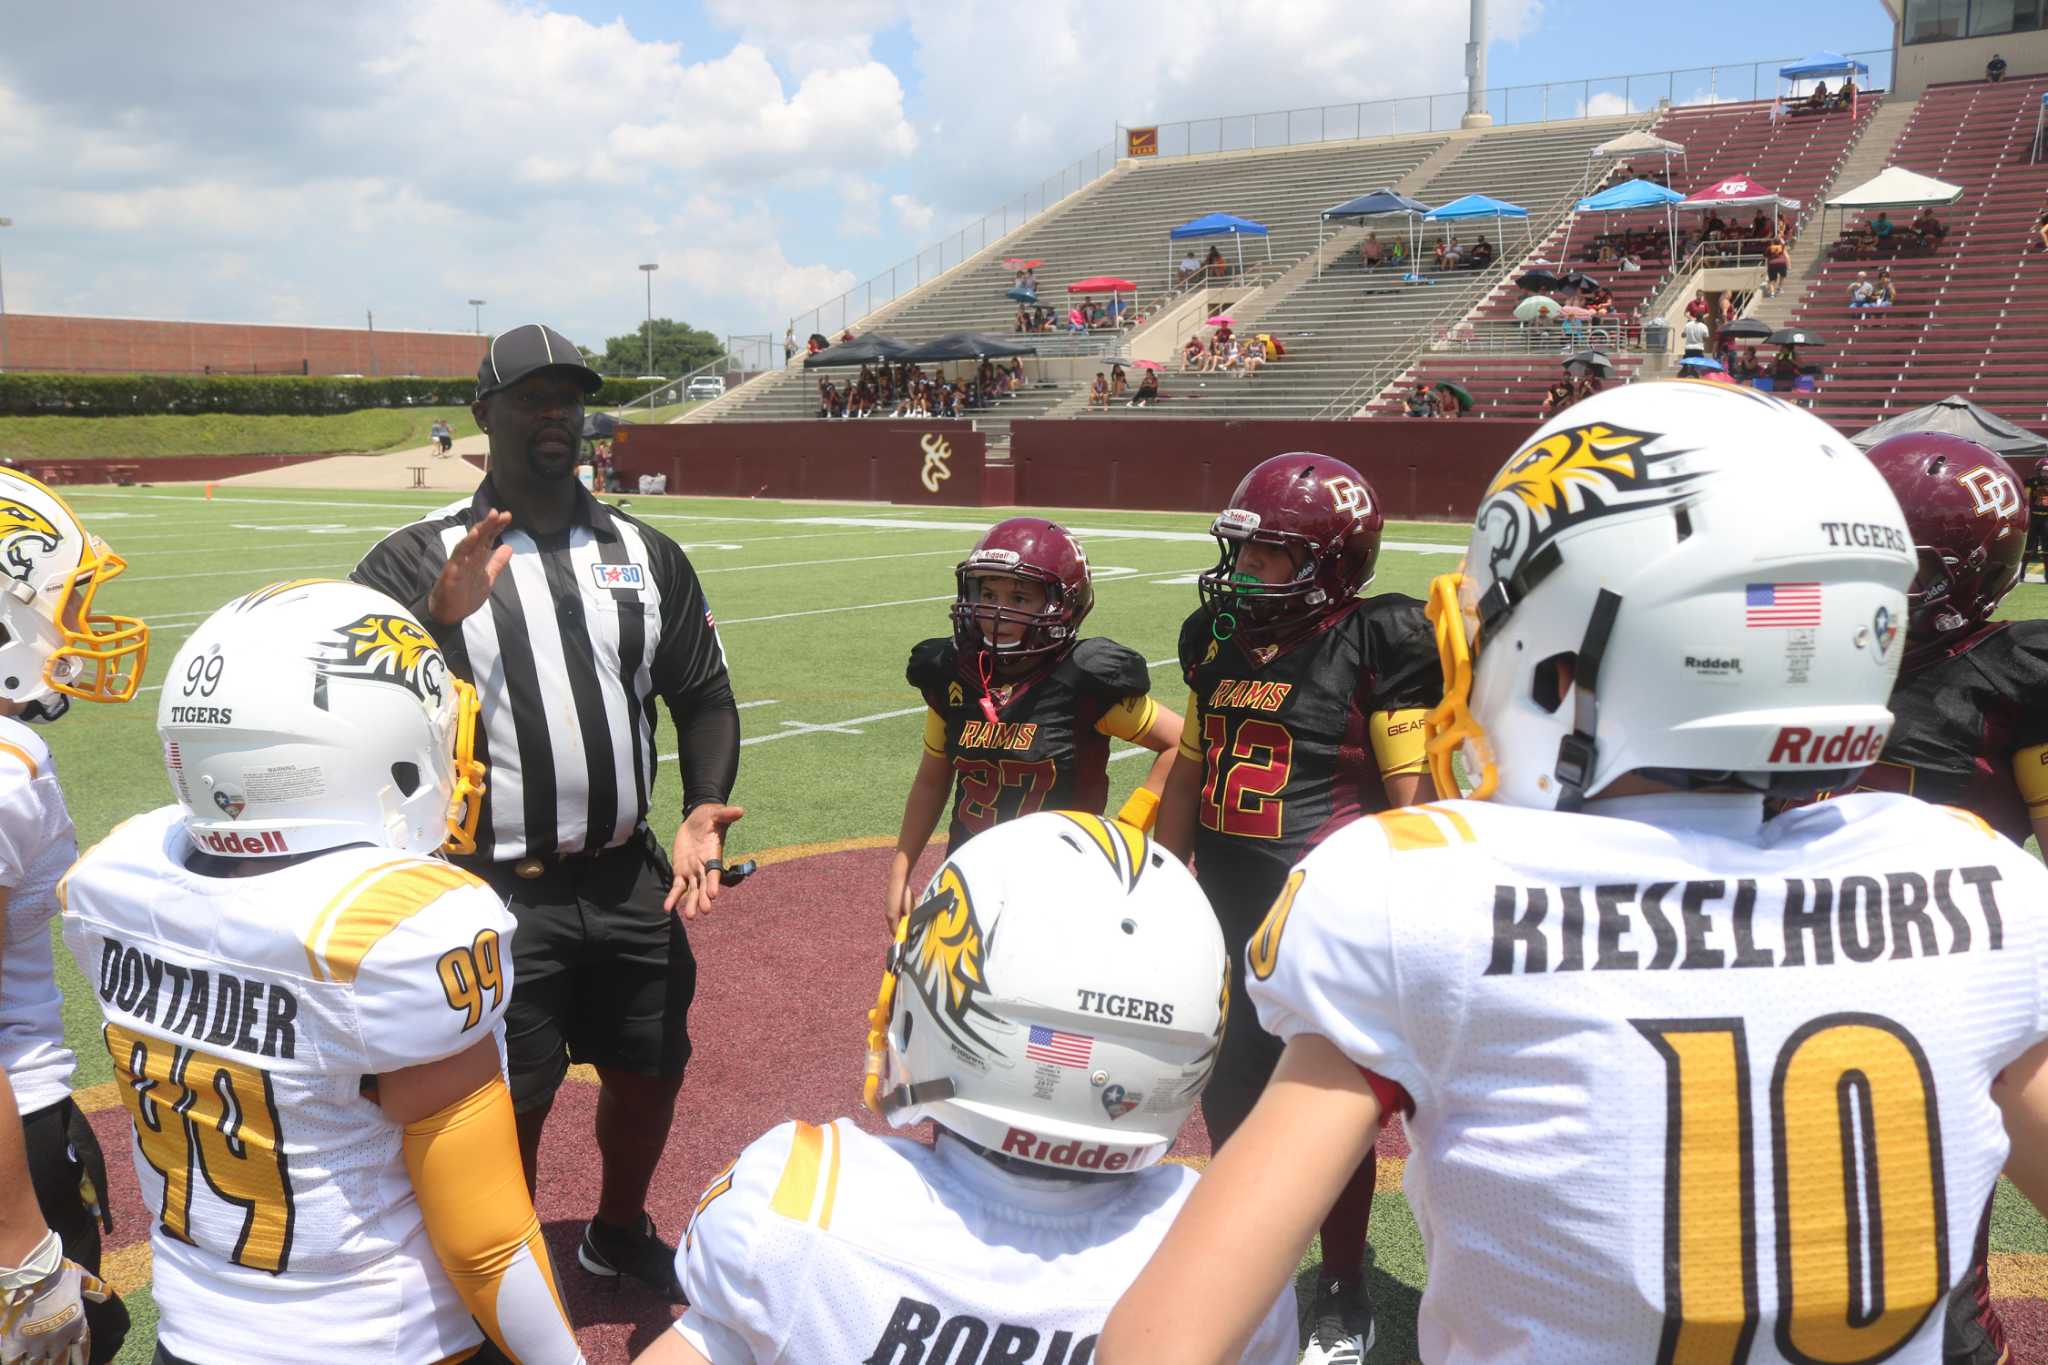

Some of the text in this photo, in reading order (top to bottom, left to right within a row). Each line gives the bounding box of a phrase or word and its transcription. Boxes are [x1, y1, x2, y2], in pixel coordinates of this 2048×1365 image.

[1820, 521, 1907, 553] TIGERS
[183, 654, 224, 697] 99
[1684, 656, 1740, 669] Riddell
[171, 706, 232, 725] TIGERS
[1208, 679, 1293, 712] RAMS
[958, 720, 1038, 750] RAMS
[952, 755, 1057, 834] 27
[1200, 713, 1293, 839] 12
[1482, 864, 2004, 977] KIESELHORST
[99, 936, 298, 1060] DOXTADER
[435, 928, 504, 1034] 99
[1077, 988, 1174, 1026] TIGERS
[1626, 1010, 1950, 1365] 10
